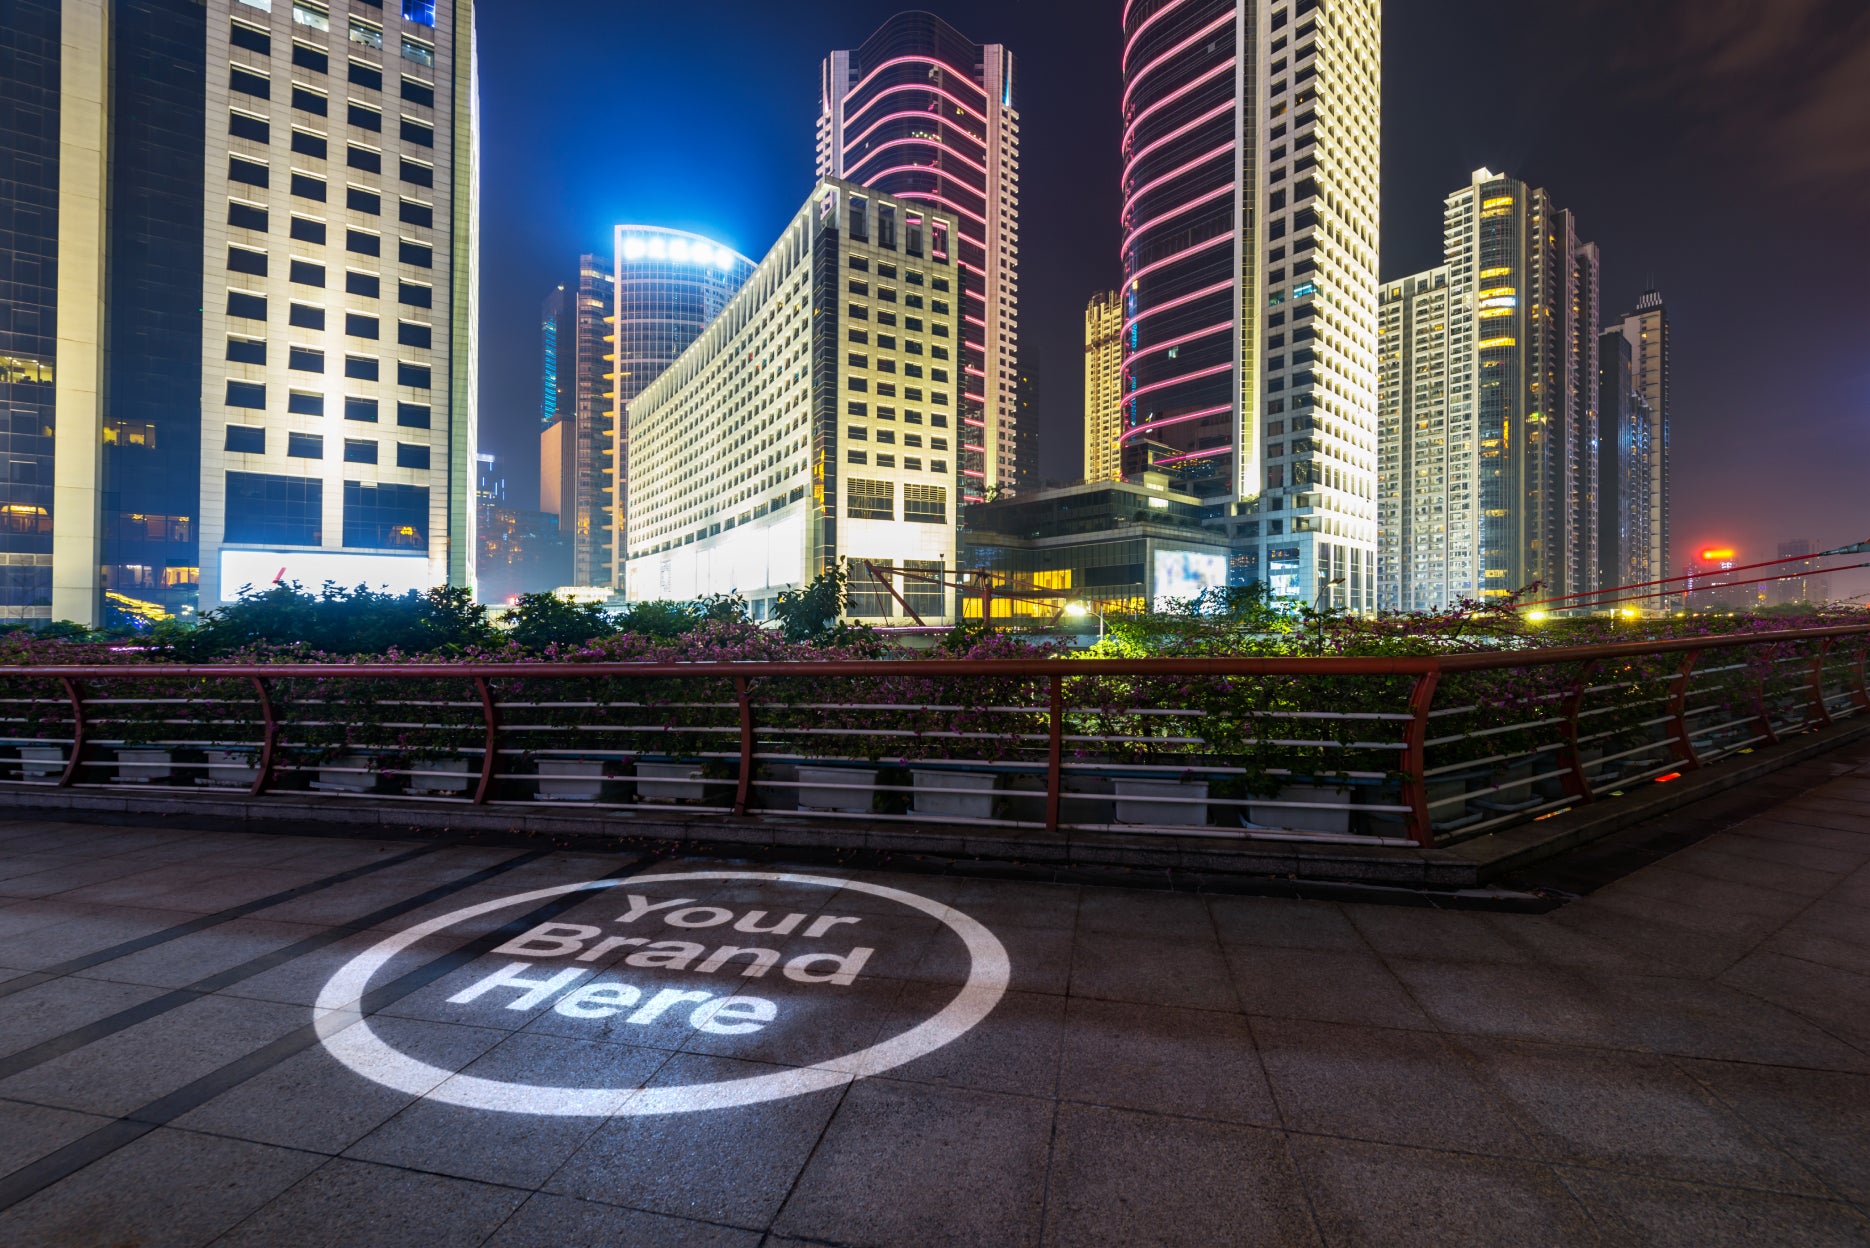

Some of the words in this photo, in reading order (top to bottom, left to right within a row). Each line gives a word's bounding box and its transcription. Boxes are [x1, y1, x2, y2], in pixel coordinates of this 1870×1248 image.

[615, 894, 861, 937] Your
[491, 921, 874, 985] Brand
[446, 962, 778, 1034] Here
